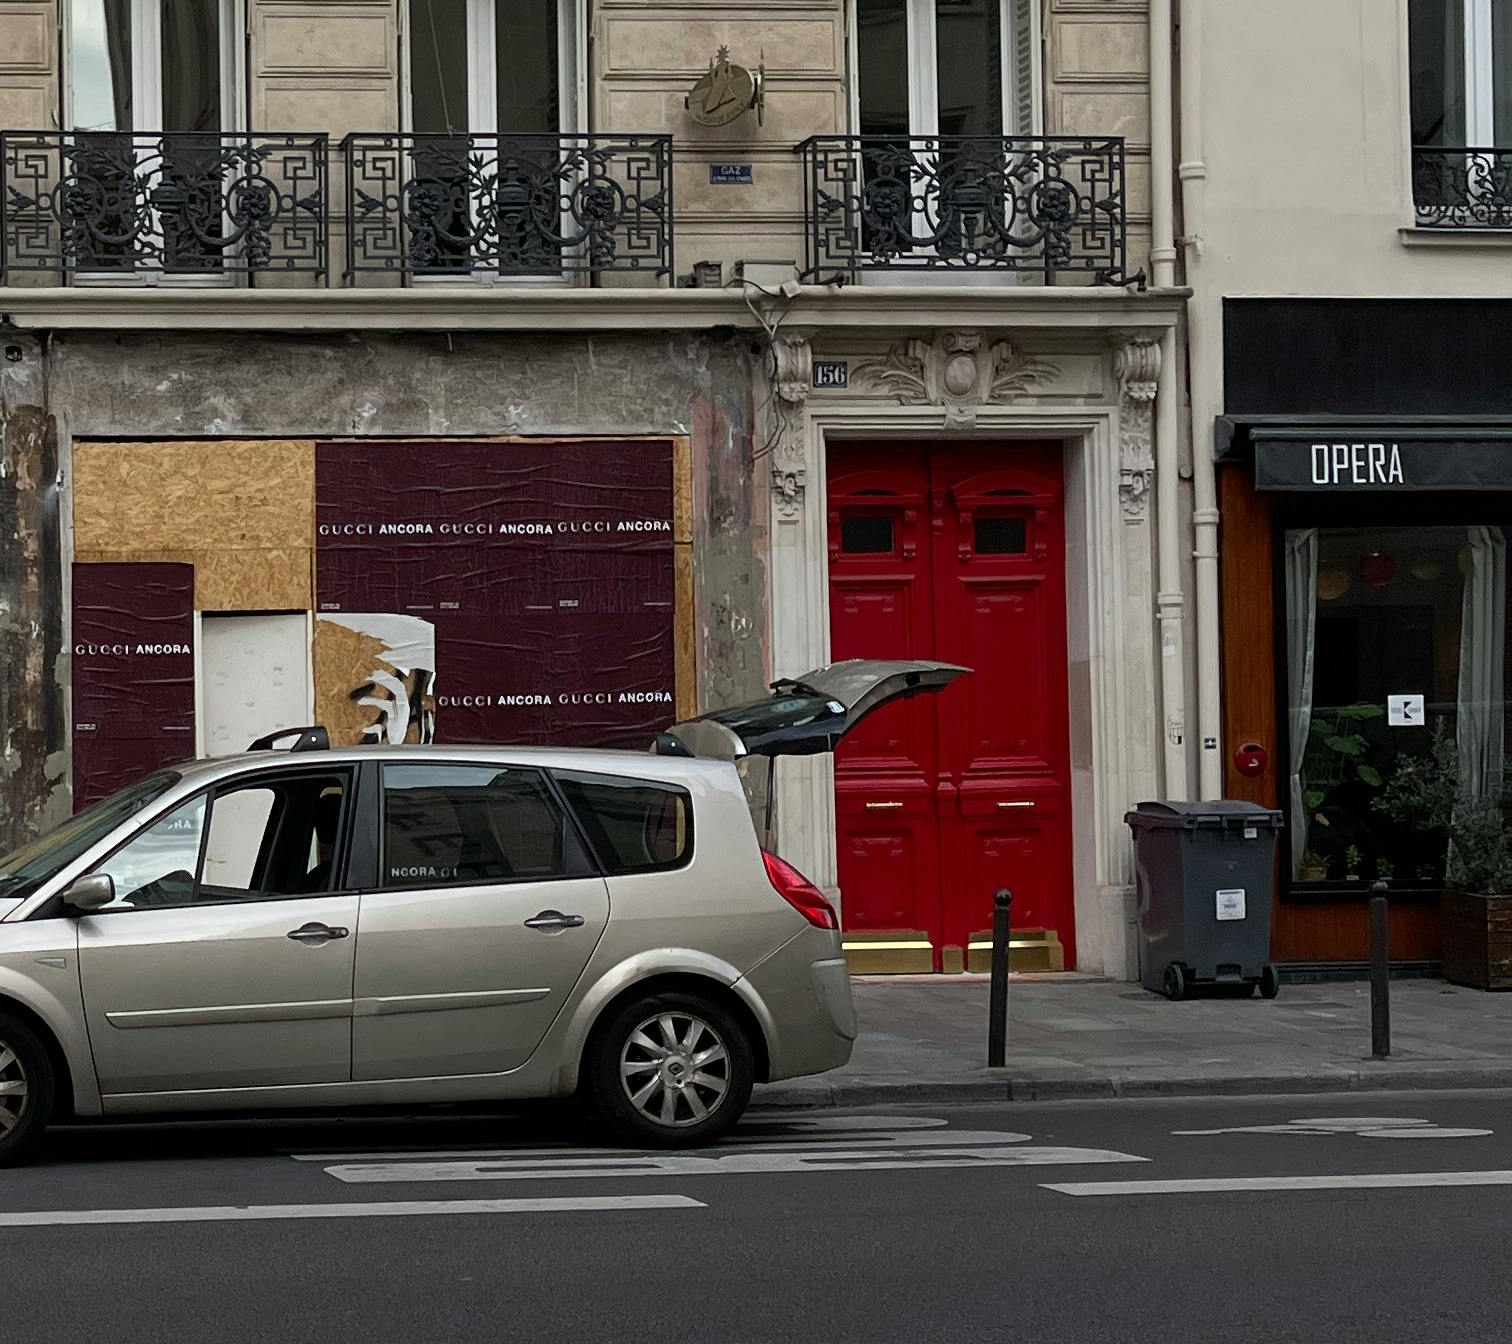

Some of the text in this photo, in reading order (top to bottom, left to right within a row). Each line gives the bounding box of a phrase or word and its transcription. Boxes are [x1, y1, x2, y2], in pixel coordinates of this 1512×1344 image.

[721, 166, 741, 175] GAZ
[817, 365, 845, 384] 156
[1311, 443, 1405, 485] OPERA
[318, 520, 672, 536] GUCCI ANCORA GUCCI ANCORA GUCCI ANCORA
[74, 643, 192, 656] GUCCI ANCORA
[438, 691, 673, 707] GUCCI ANCORA GUCCI ANCORA
